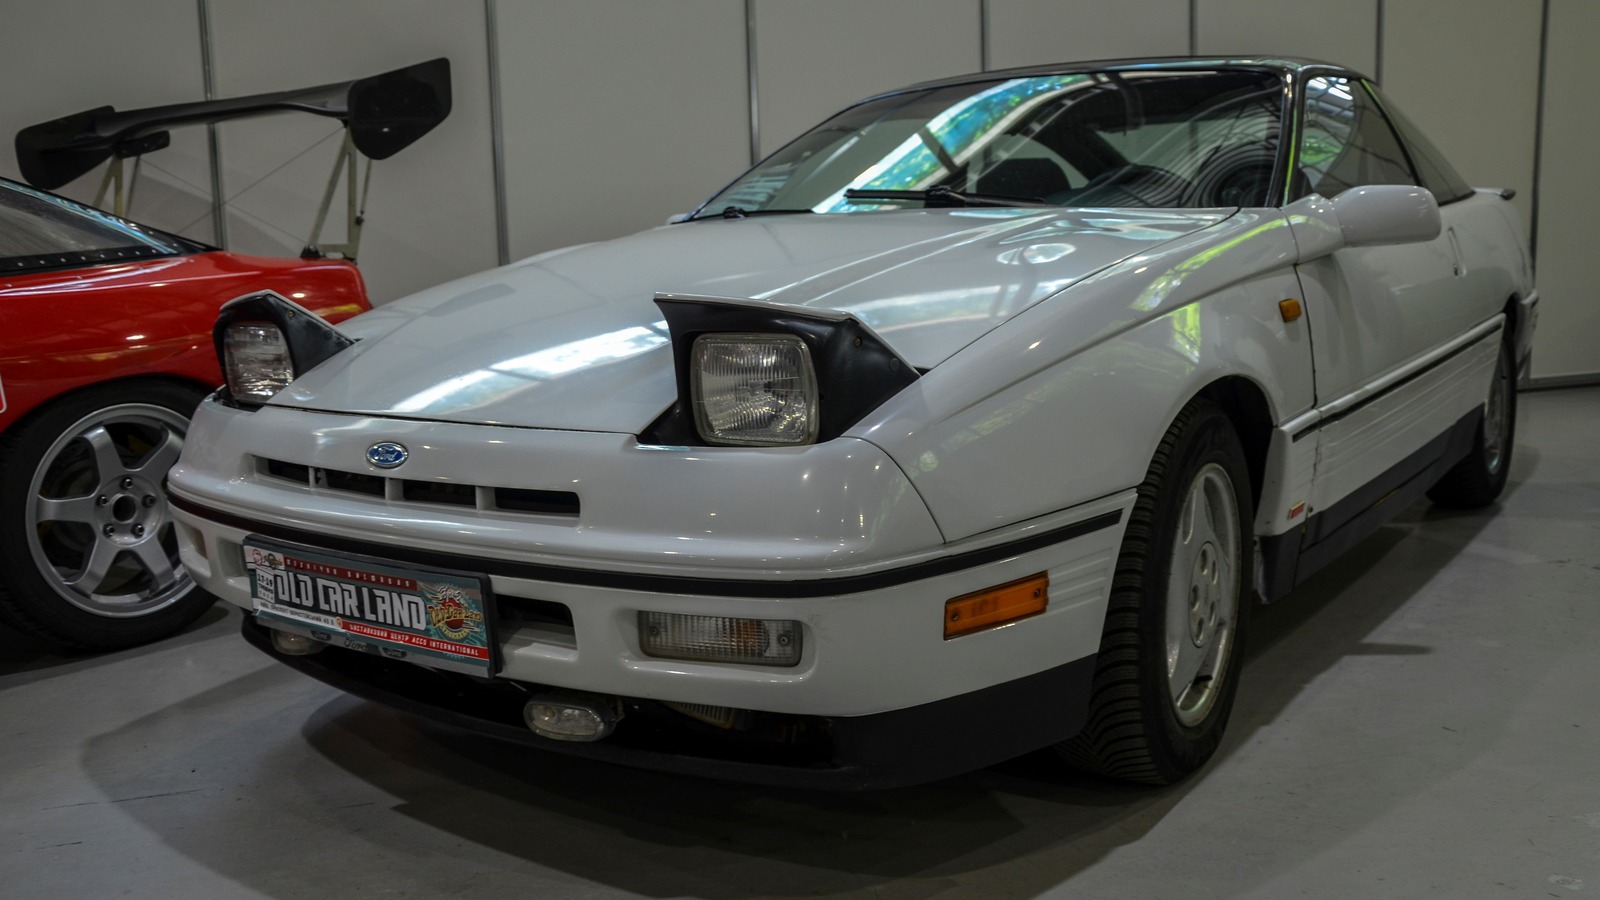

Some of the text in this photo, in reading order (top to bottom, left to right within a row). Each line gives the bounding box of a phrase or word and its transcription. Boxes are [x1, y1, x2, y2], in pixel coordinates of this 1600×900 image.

[257, 573, 273, 587] 17-19
[274, 569, 314, 607] OLD
[316, 577, 360, 618] CAR
[362, 586, 427, 631] LAND
[390, 632, 409, 642] ЦЕНТР
[430, 640, 479, 656] INTERNATIONAL
